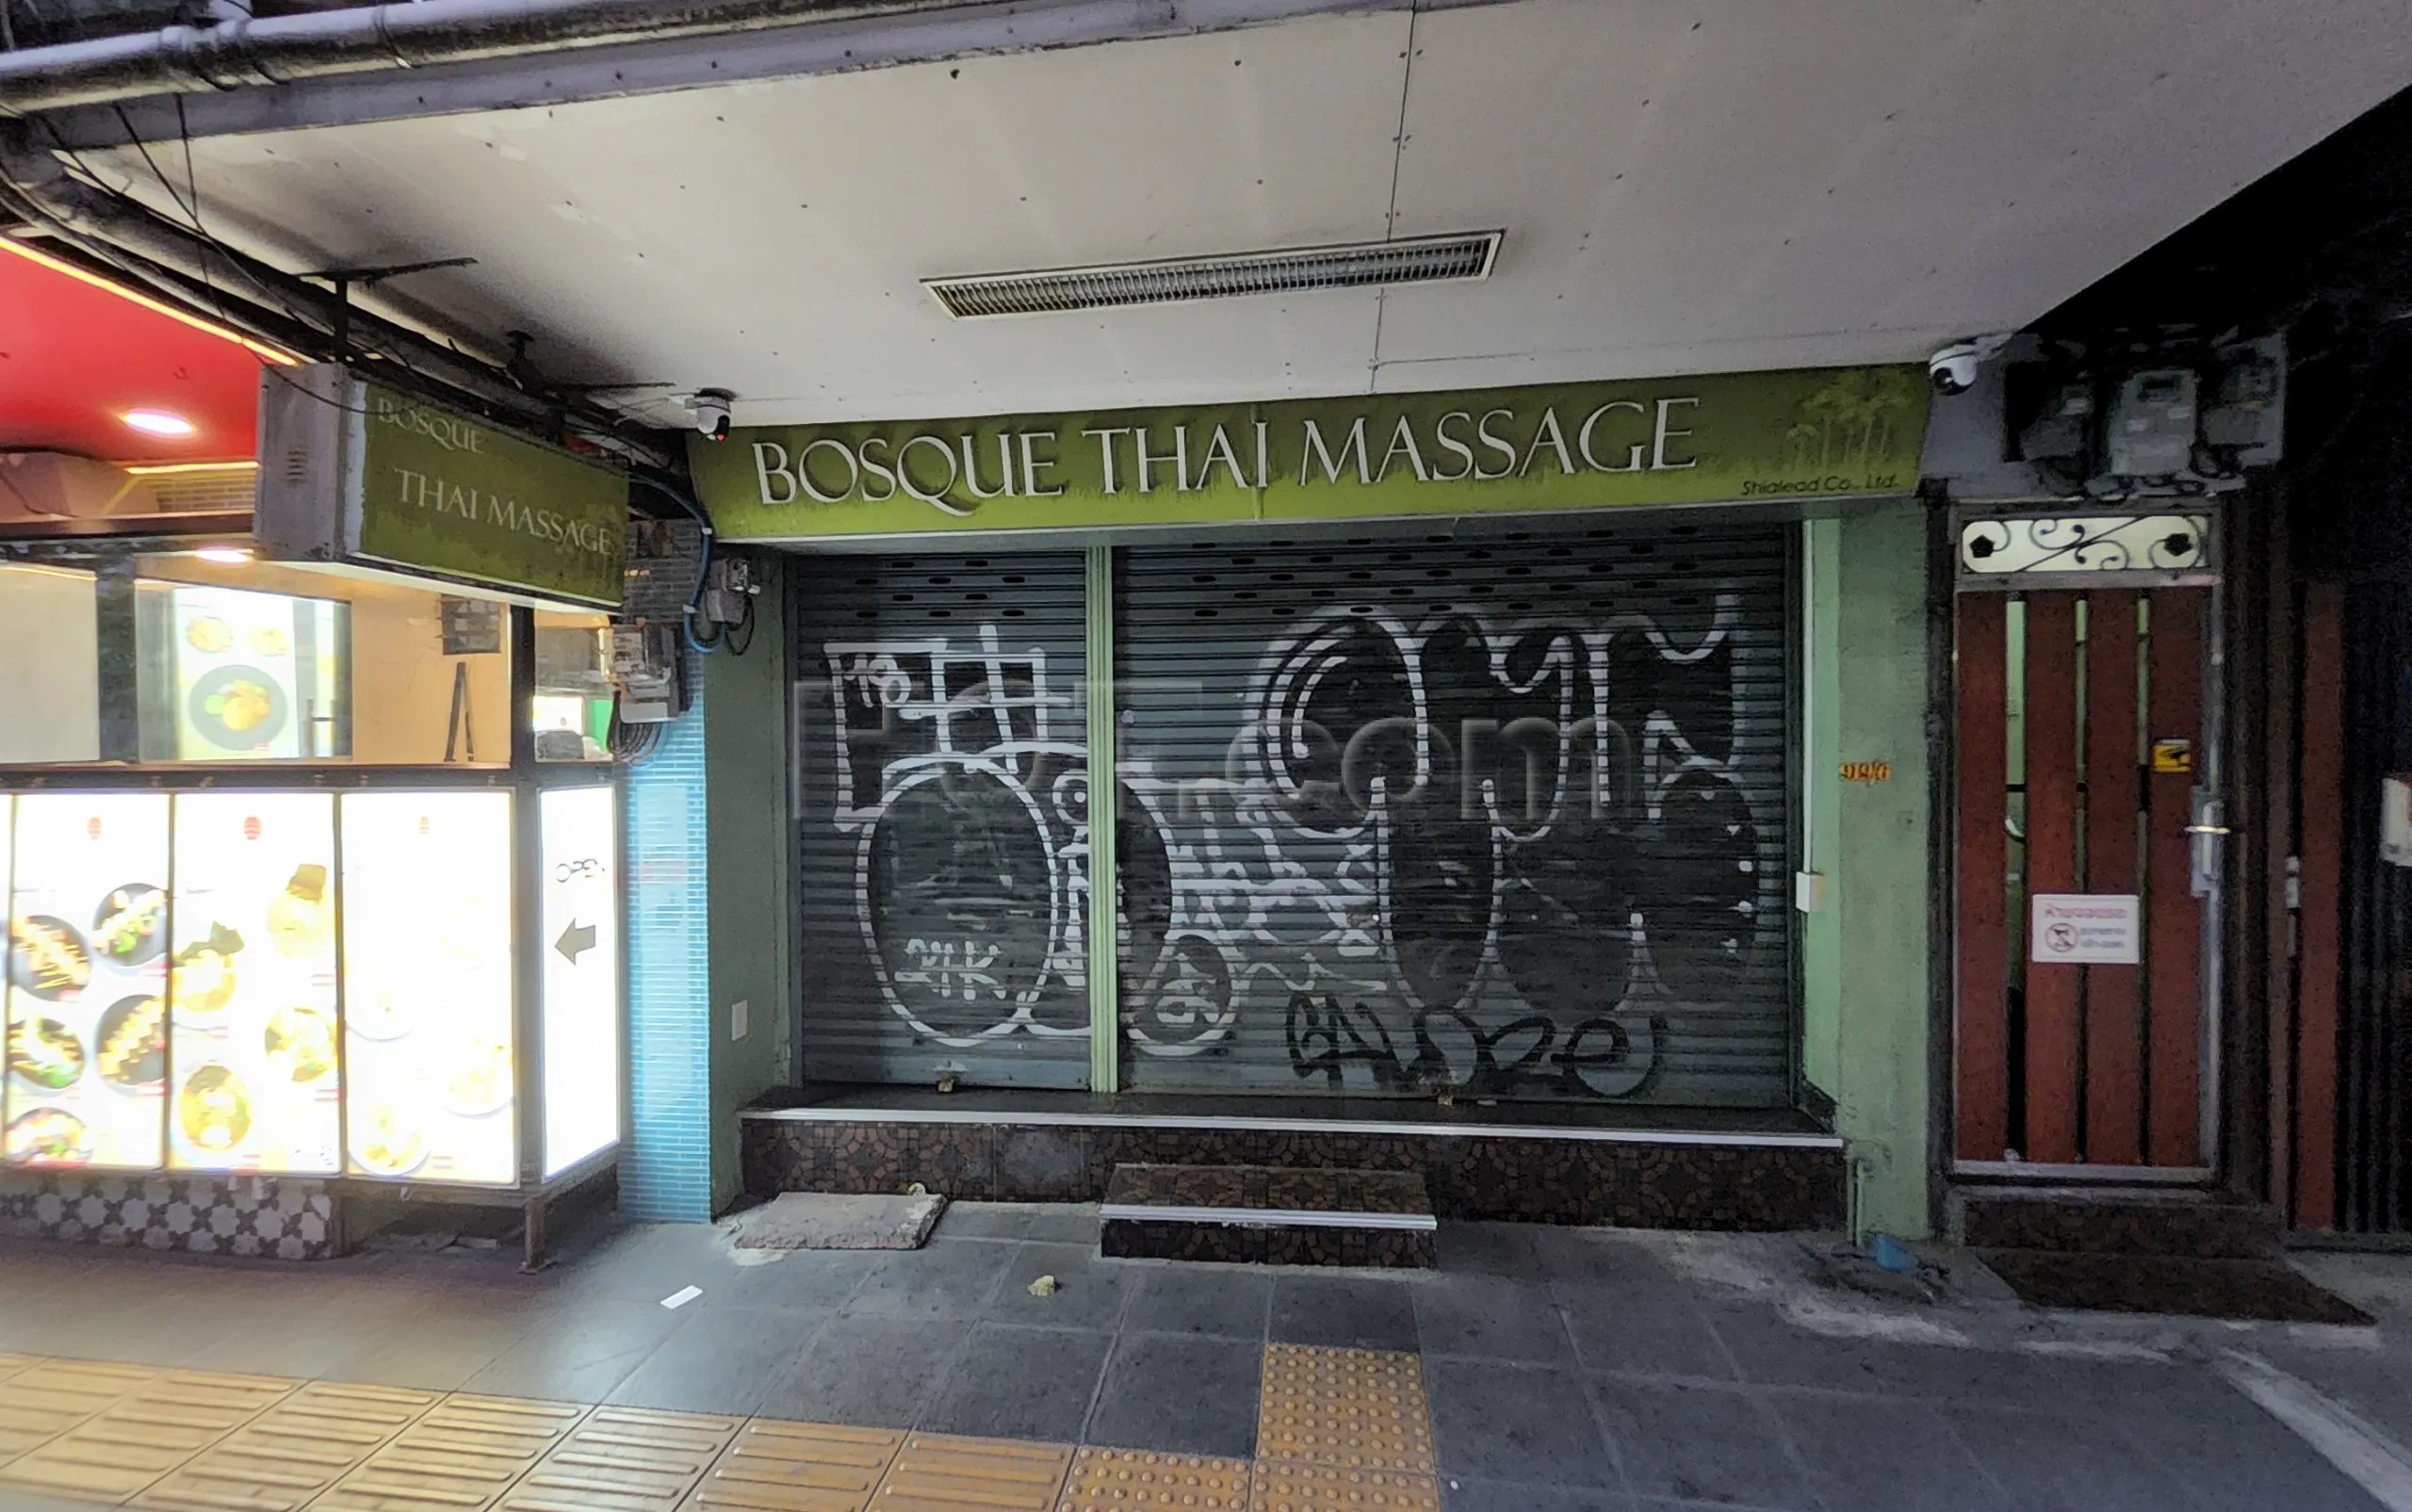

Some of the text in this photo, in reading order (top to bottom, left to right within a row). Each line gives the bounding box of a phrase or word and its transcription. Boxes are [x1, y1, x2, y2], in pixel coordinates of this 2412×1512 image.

[378, 396, 484, 454] BOSQUE
[751, 397, 1701, 516] BOSQUE THAI MASSAGE
[393, 467, 614, 556] THAI MASSAGE
